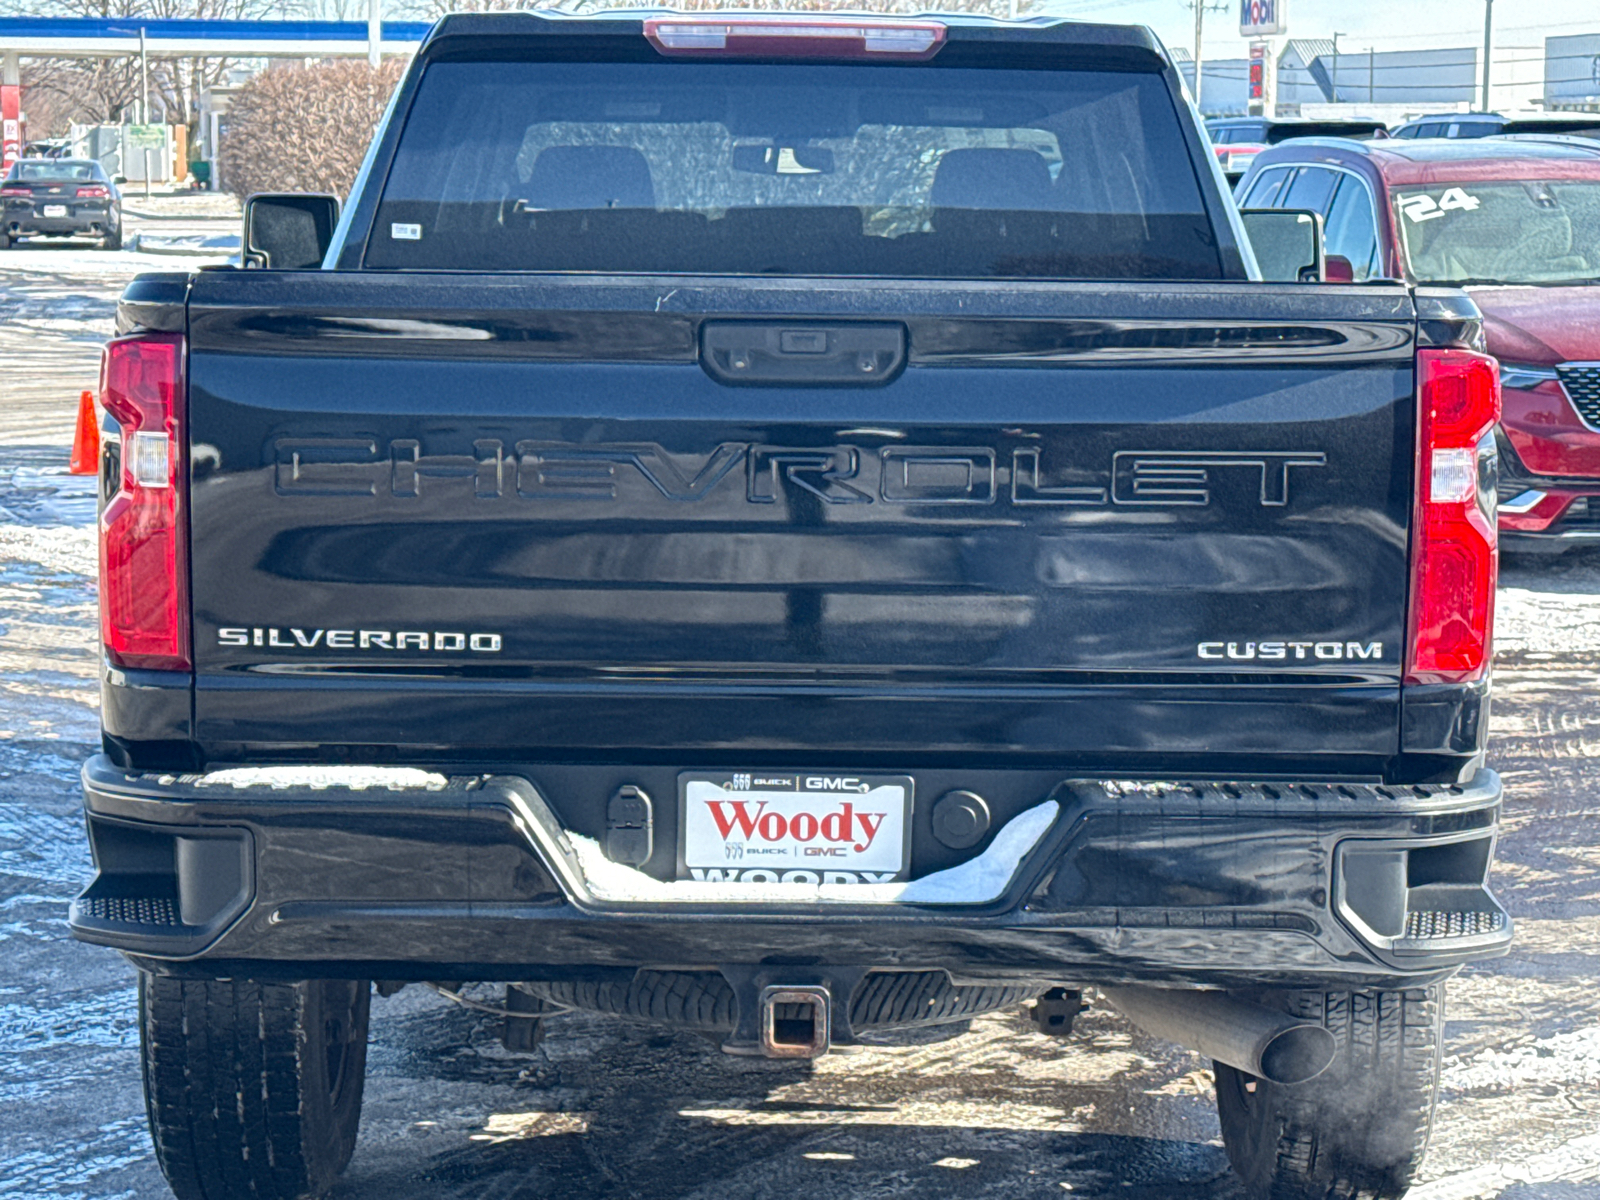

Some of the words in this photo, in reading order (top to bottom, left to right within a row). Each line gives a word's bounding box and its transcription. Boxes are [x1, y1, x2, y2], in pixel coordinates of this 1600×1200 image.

[1240, 0, 1275, 26] Mobil
[275, 438, 1327, 506] CHEVROLET
[218, 627, 502, 653] SILVERADO
[1197, 641, 1383, 660] CUSTOM
[753, 778, 792, 786] BUICK
[805, 777, 860, 790] GMC
[704, 800, 888, 853] Woody
[803, 847, 847, 857] GMC
